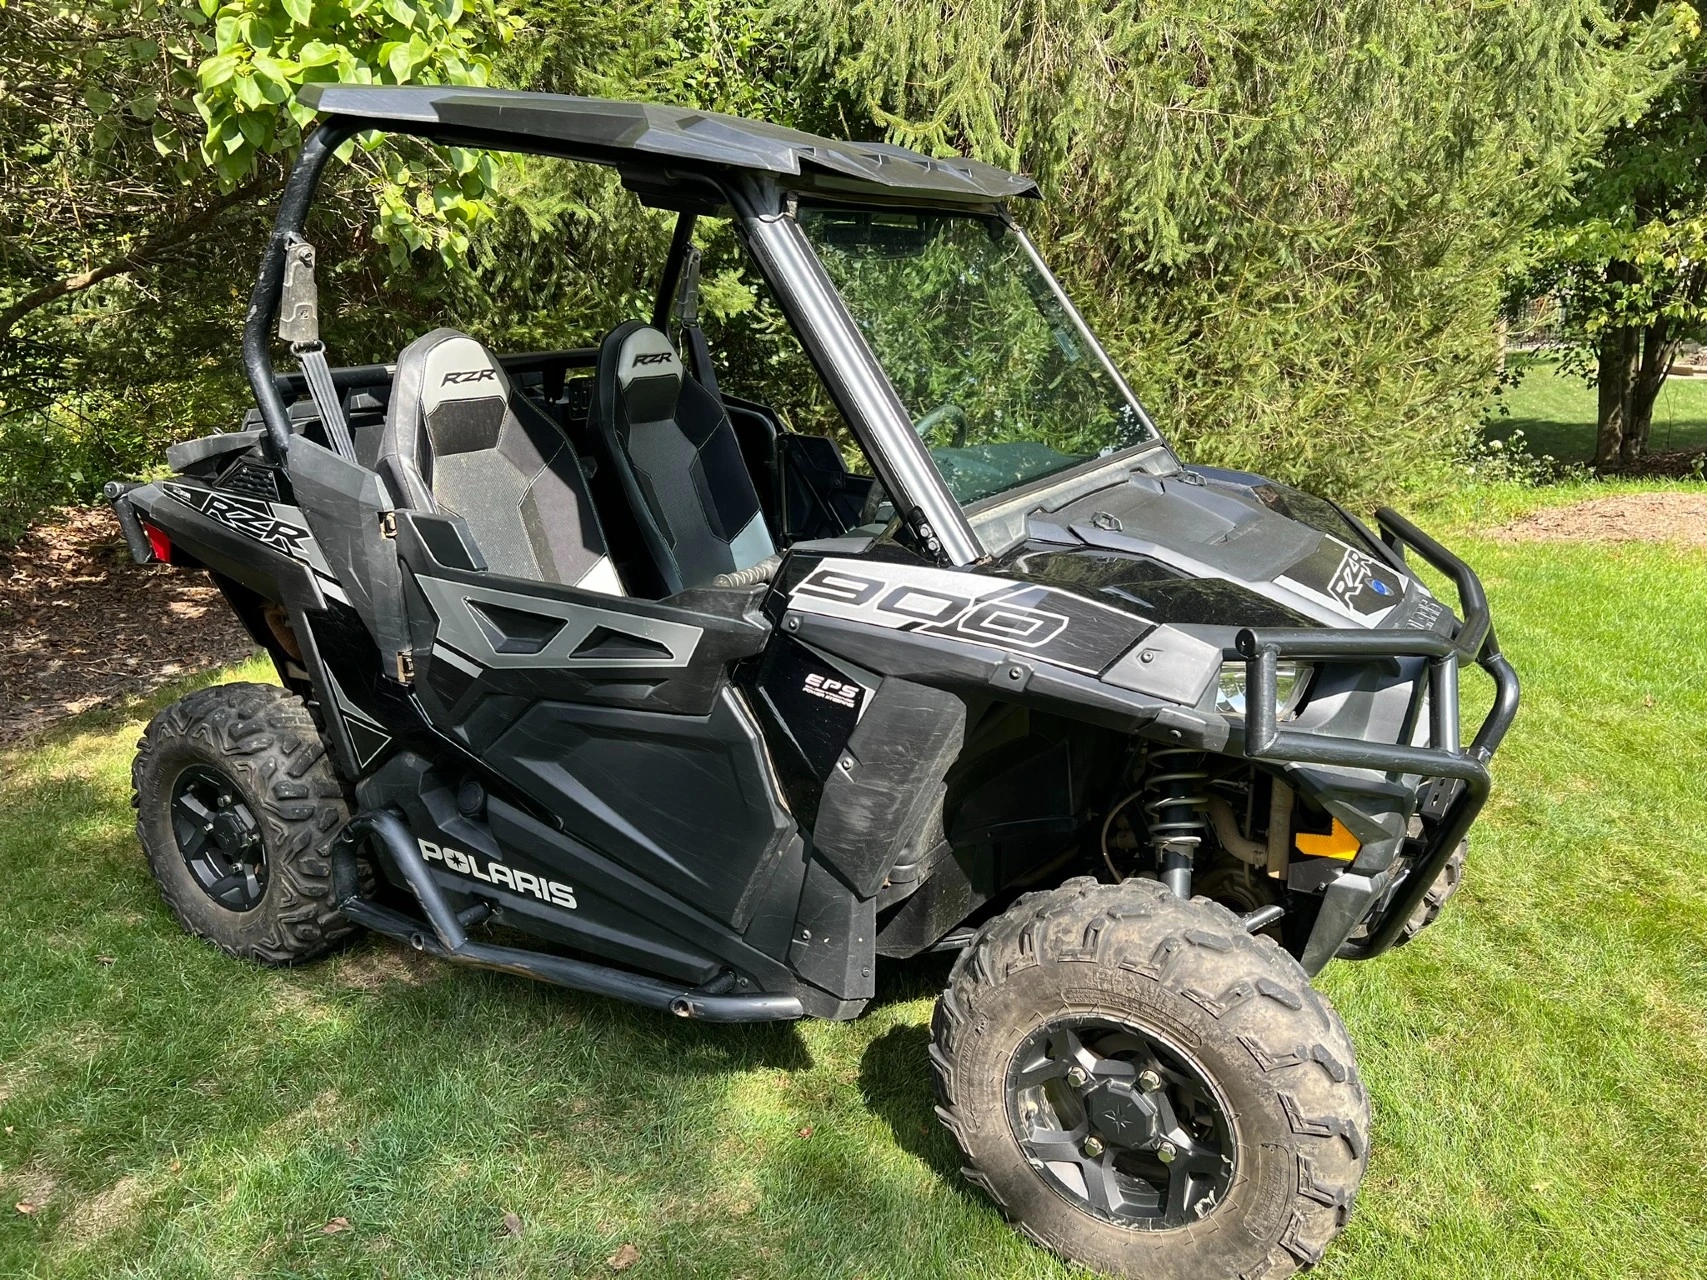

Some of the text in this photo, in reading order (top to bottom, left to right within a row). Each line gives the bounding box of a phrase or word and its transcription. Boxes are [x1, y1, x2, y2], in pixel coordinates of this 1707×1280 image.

[440, 368, 496, 388] RZR
[632, 352, 673, 368] RZR
[205, 494, 314, 555] RZR
[1327, 547, 1373, 617] RZR
[804, 673, 859, 698] EPS
[417, 838, 577, 910] POLARIS
